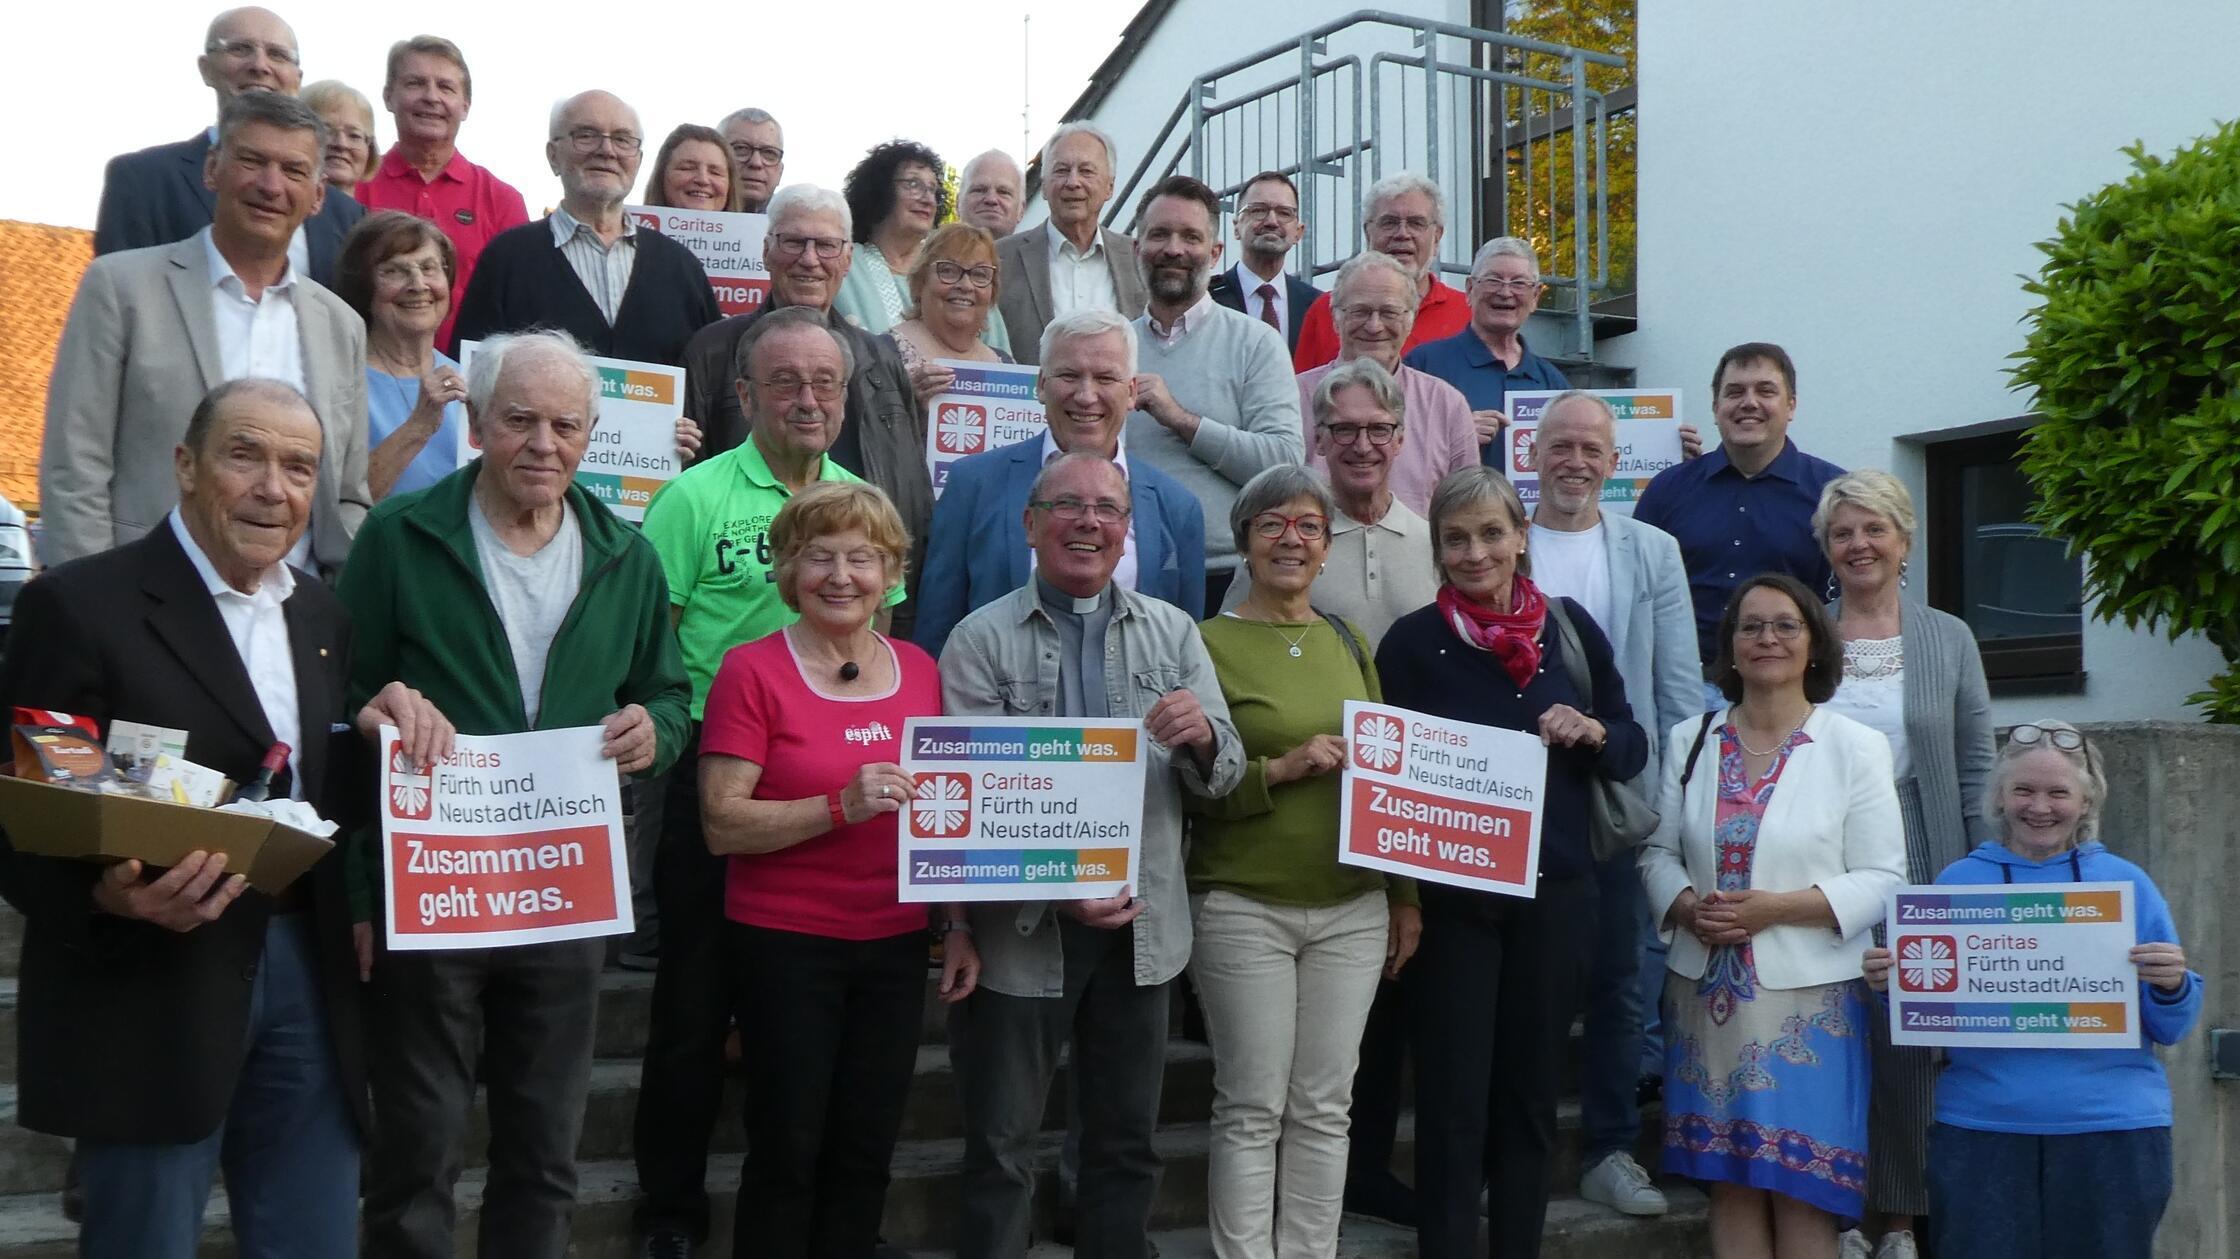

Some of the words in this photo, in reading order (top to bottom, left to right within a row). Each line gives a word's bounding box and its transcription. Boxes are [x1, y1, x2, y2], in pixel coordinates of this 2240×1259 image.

[668, 216, 723, 232] Caritas
[713, 240, 740, 252] und
[700, 257, 763, 271] tadt/Ais
[620, 383, 658, 397] was.
[1629, 406, 1660, 414] was.
[590, 430, 621, 444] und
[994, 426, 1034, 440] Fürth
[582, 450, 670, 471] adt/Aisch
[616, 489, 650, 502] was
[723, 516, 771, 529] EXPLORE
[712, 530, 728, 540] THE
[732, 525, 768, 536] NORTHE
[845, 720, 893, 745] esprit
[1412, 722, 1468, 747] Caritas
[918, 738, 1024, 755] Zusammen
[1030, 739, 1071, 757] geht
[1076, 741, 1118, 756] was.
[1410, 744, 1450, 767] Fürth
[1456, 757, 1488, 772] und
[440, 774, 482, 794] Fürth
[490, 773, 534, 794] und
[982, 772, 1053, 790] Caritas
[1409, 765, 1533, 802] Neustadt/Aisch
[440, 794, 605, 823] Neustadt/Aisch
[982, 797, 1032, 814] Fürth
[1041, 798, 1077, 814] und
[1370, 786, 1510, 838] Zusammen
[981, 821, 1129, 838] Neustadt/Aisch
[1378, 827, 1430, 857] geht
[1438, 839, 1496, 868] was.
[407, 841, 584, 874] Zusammen
[916, 862, 1019, 878] Zusammen
[1025, 861, 1066, 880] geht
[1072, 862, 1110, 876] was.
[419, 885, 479, 926] geht
[486, 887, 573, 916] was.
[1902, 904, 2006, 920] Zusammen
[2011, 903, 2054, 922] geht
[2059, 903, 2102, 918] was.
[1967, 935, 2038, 950] Caritas
[1968, 956, 2021, 971] Fürth
[2027, 956, 2064, 971] und
[1968, 977, 2124, 993] Neustadt/Aisch
[1907, 1012, 2010, 1028] Zusammen
[2016, 1012, 2058, 1030] geht
[2063, 1014, 2107, 1028] was.
